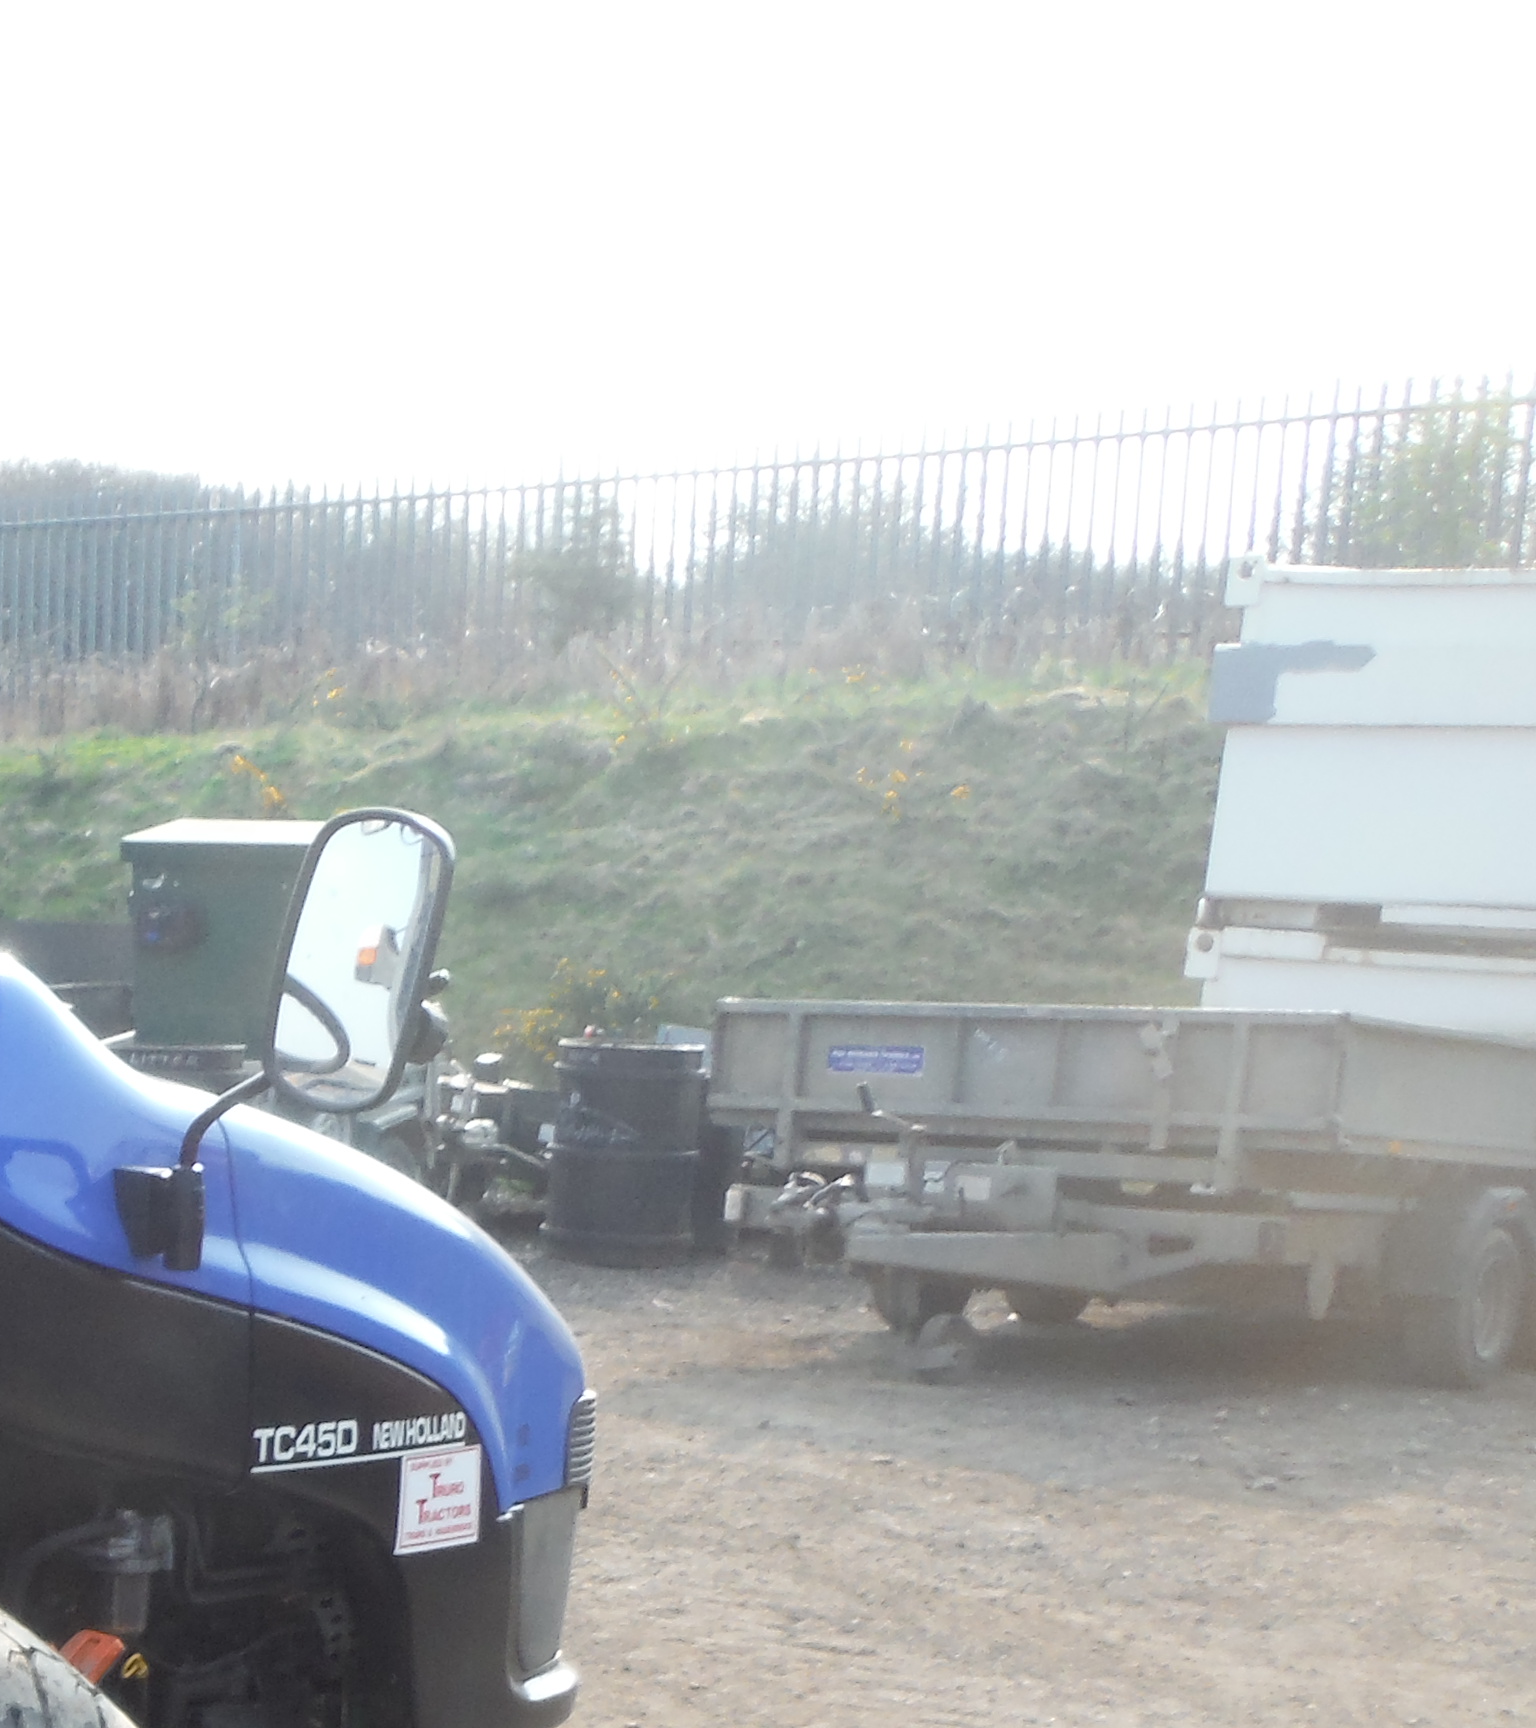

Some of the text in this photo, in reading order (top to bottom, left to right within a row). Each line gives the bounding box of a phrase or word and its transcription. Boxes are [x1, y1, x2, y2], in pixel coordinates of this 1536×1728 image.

[253, 1418, 358, 1463] TC45D
[405, 1411, 467, 1447] HOLLAND
[416, 1498, 471, 1524] TRACTORS
